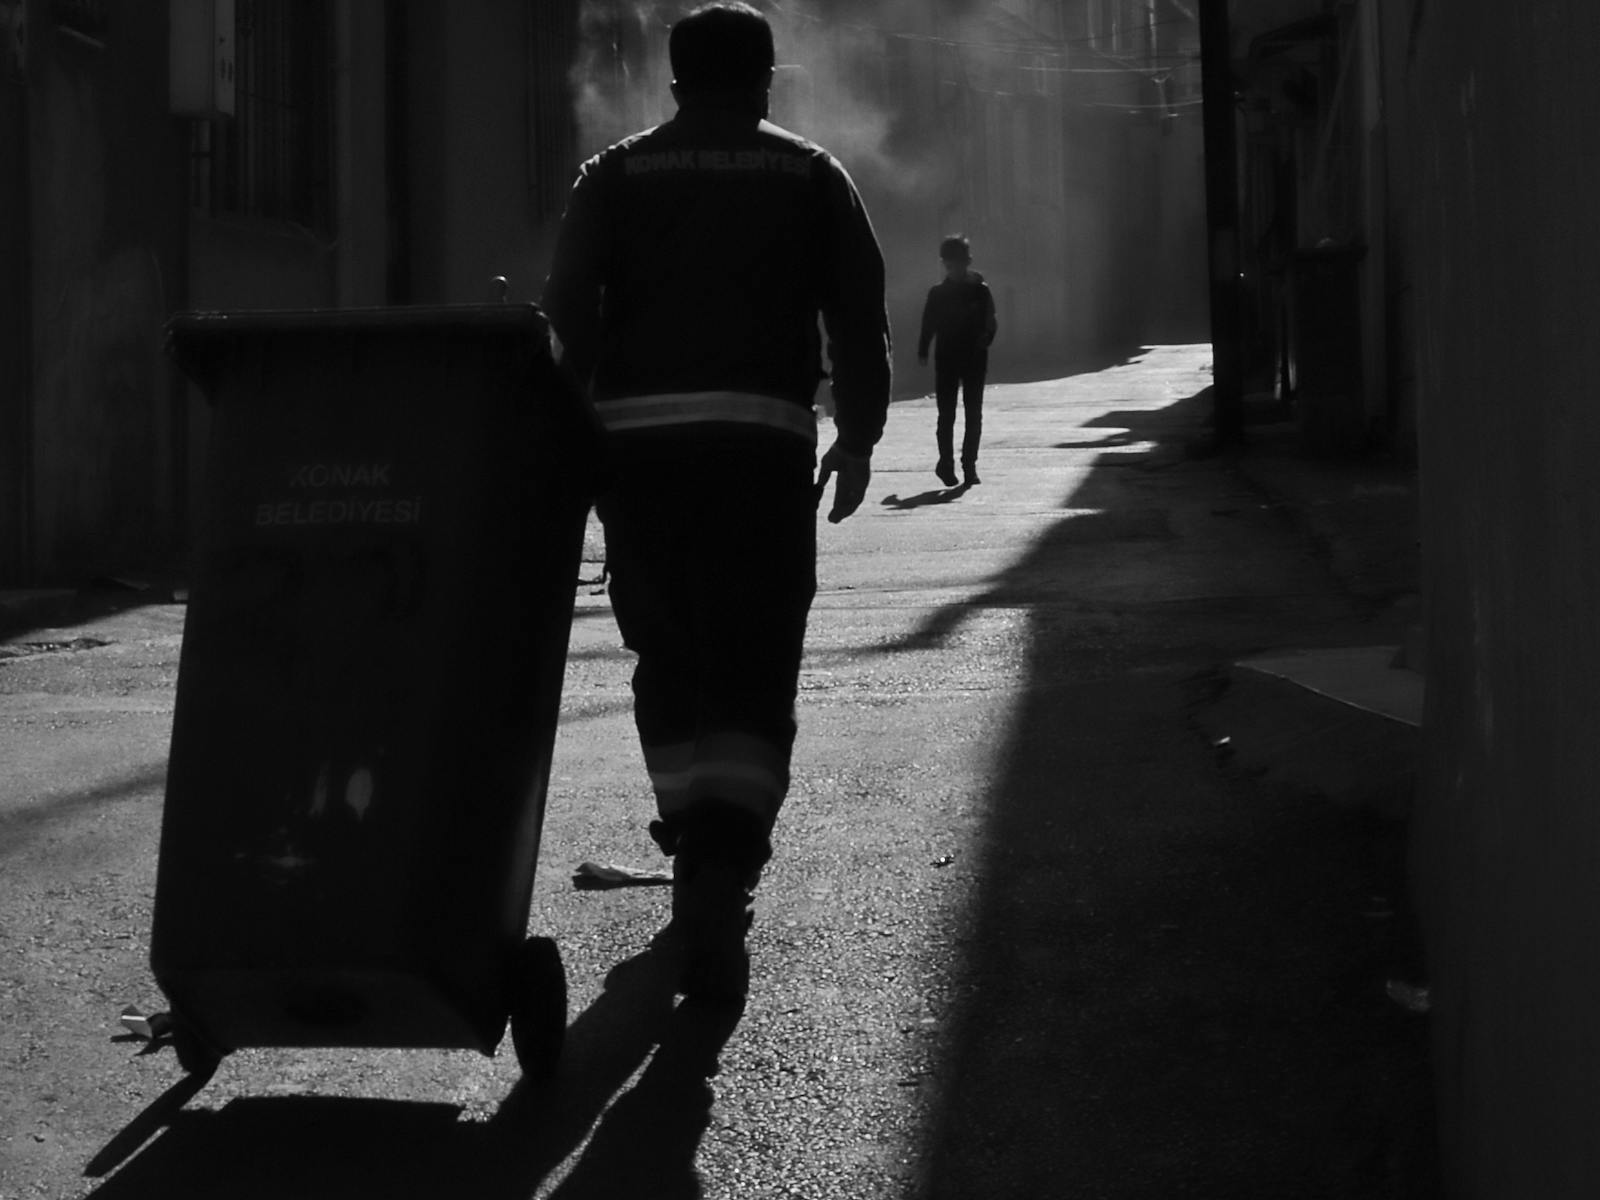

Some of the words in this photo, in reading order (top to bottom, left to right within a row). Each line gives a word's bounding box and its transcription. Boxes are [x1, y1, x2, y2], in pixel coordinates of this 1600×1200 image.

[624, 150, 696, 175] KONAK
[289, 464, 391, 487] KONAK
[256, 496, 424, 526] BELEDİYESİ
